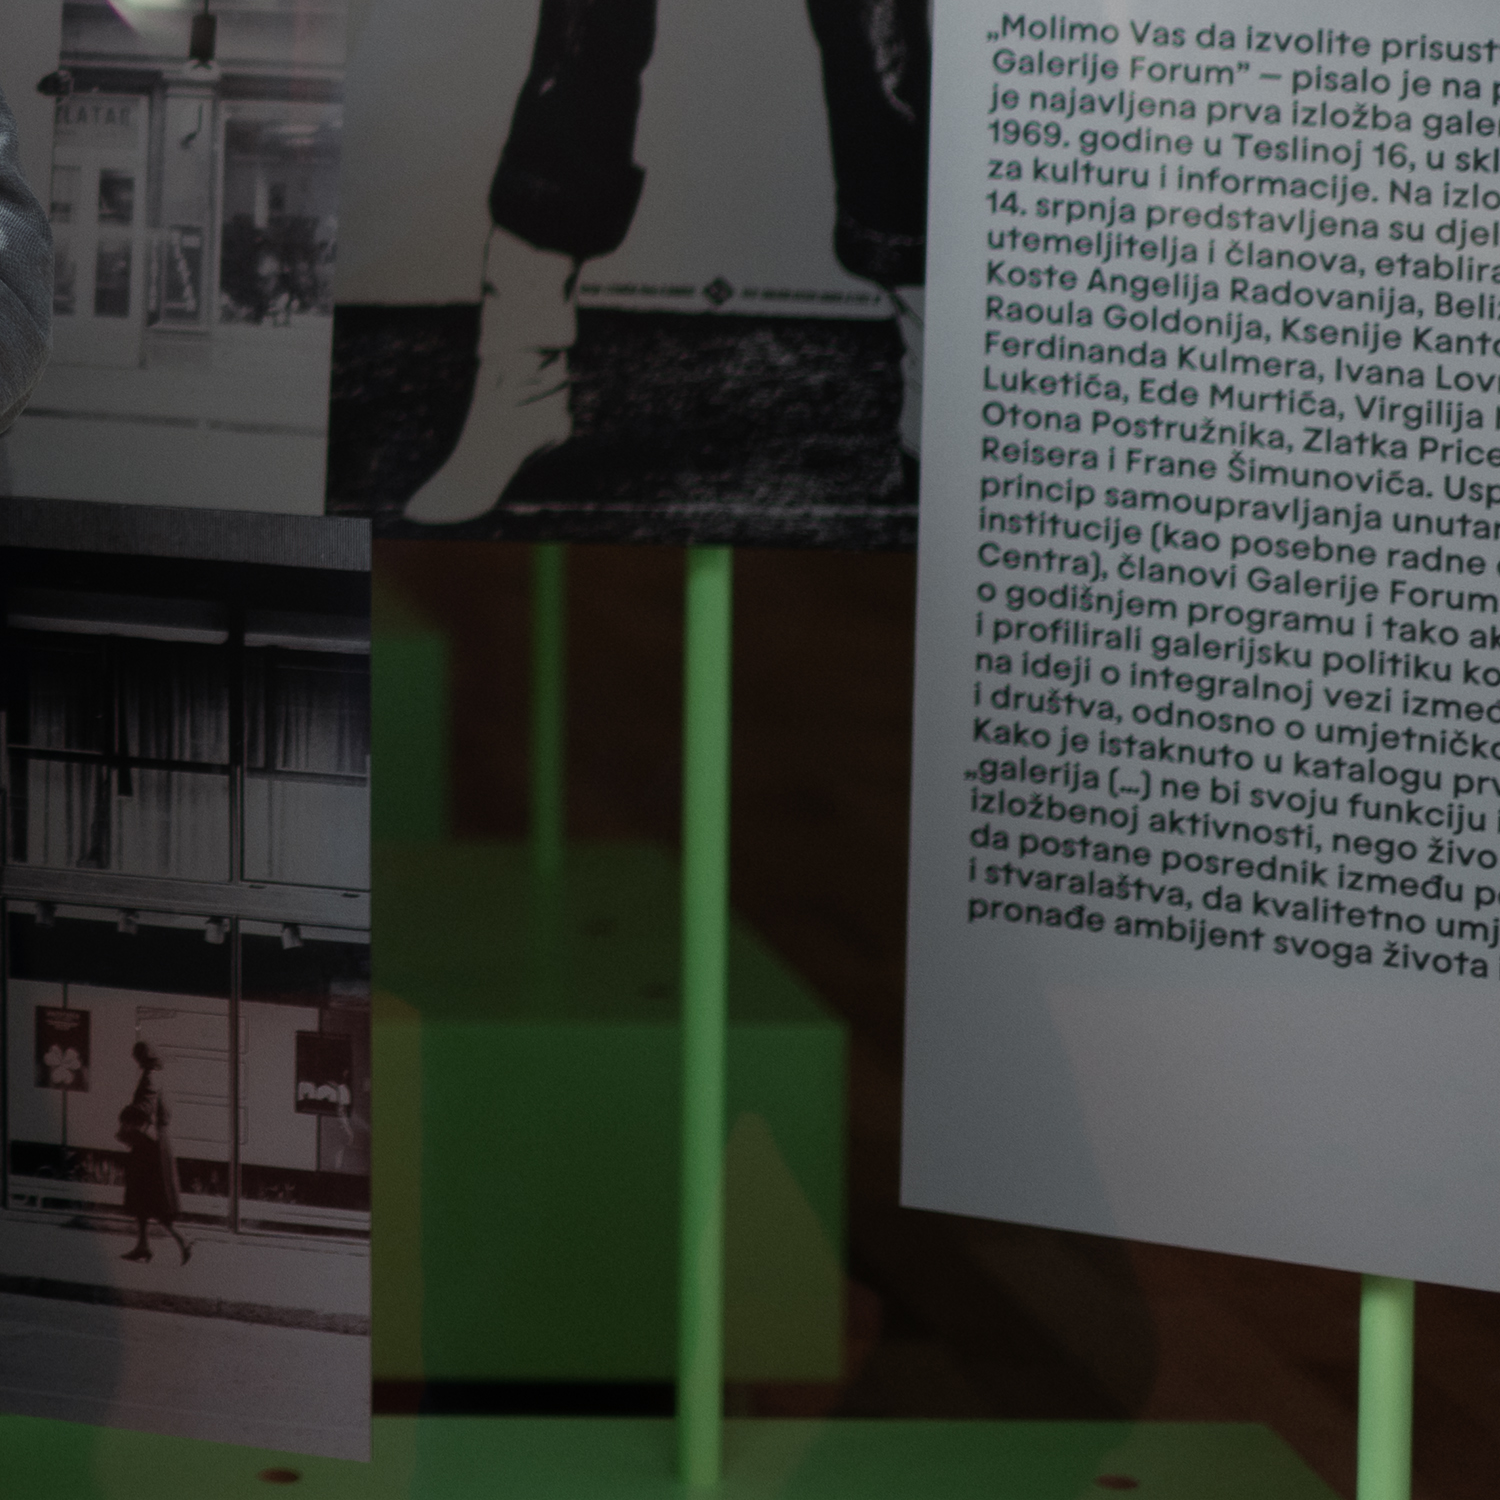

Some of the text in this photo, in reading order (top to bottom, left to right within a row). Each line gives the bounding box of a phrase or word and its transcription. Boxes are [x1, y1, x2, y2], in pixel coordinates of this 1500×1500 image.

[1129, 19, 1186, 48] Vas
[1195, 22, 1236, 51] da
[1246, 24, 1371, 58] izvolite
[991, 48, 1119, 85] Galerije
[1291, 64, 1391, 96] pisalo
[1398, 69, 1432, 102] je
[1442, 77, 1482, 100] na
[987, 82, 1412, 132] je najavljena prva izložba
[987, 118, 1070, 148] 1969.
[1079, 127, 1194, 157] godine
[1203, 137, 1222, 158] u
[1231, 132, 1362, 172] Teslinoj
[1425, 149, 1445, 171] u
[987, 156, 1432, 207] za kulturu i informacije. Na
[985, 189, 1425, 243] 14. srpnja predstavljena su
[986, 226, 1366, 278] utemeljitelja i članova,
[986, 259, 1424, 319] Koste Angelija Radovanija,
[1117, 554, 1237, 590] članovi
[1247, 566, 1379, 607] Galerije
[972, 716, 1442, 795] Kako je istaknuto u katalogu
[967, 897, 1489, 980] pronađe ambijent svoga života
